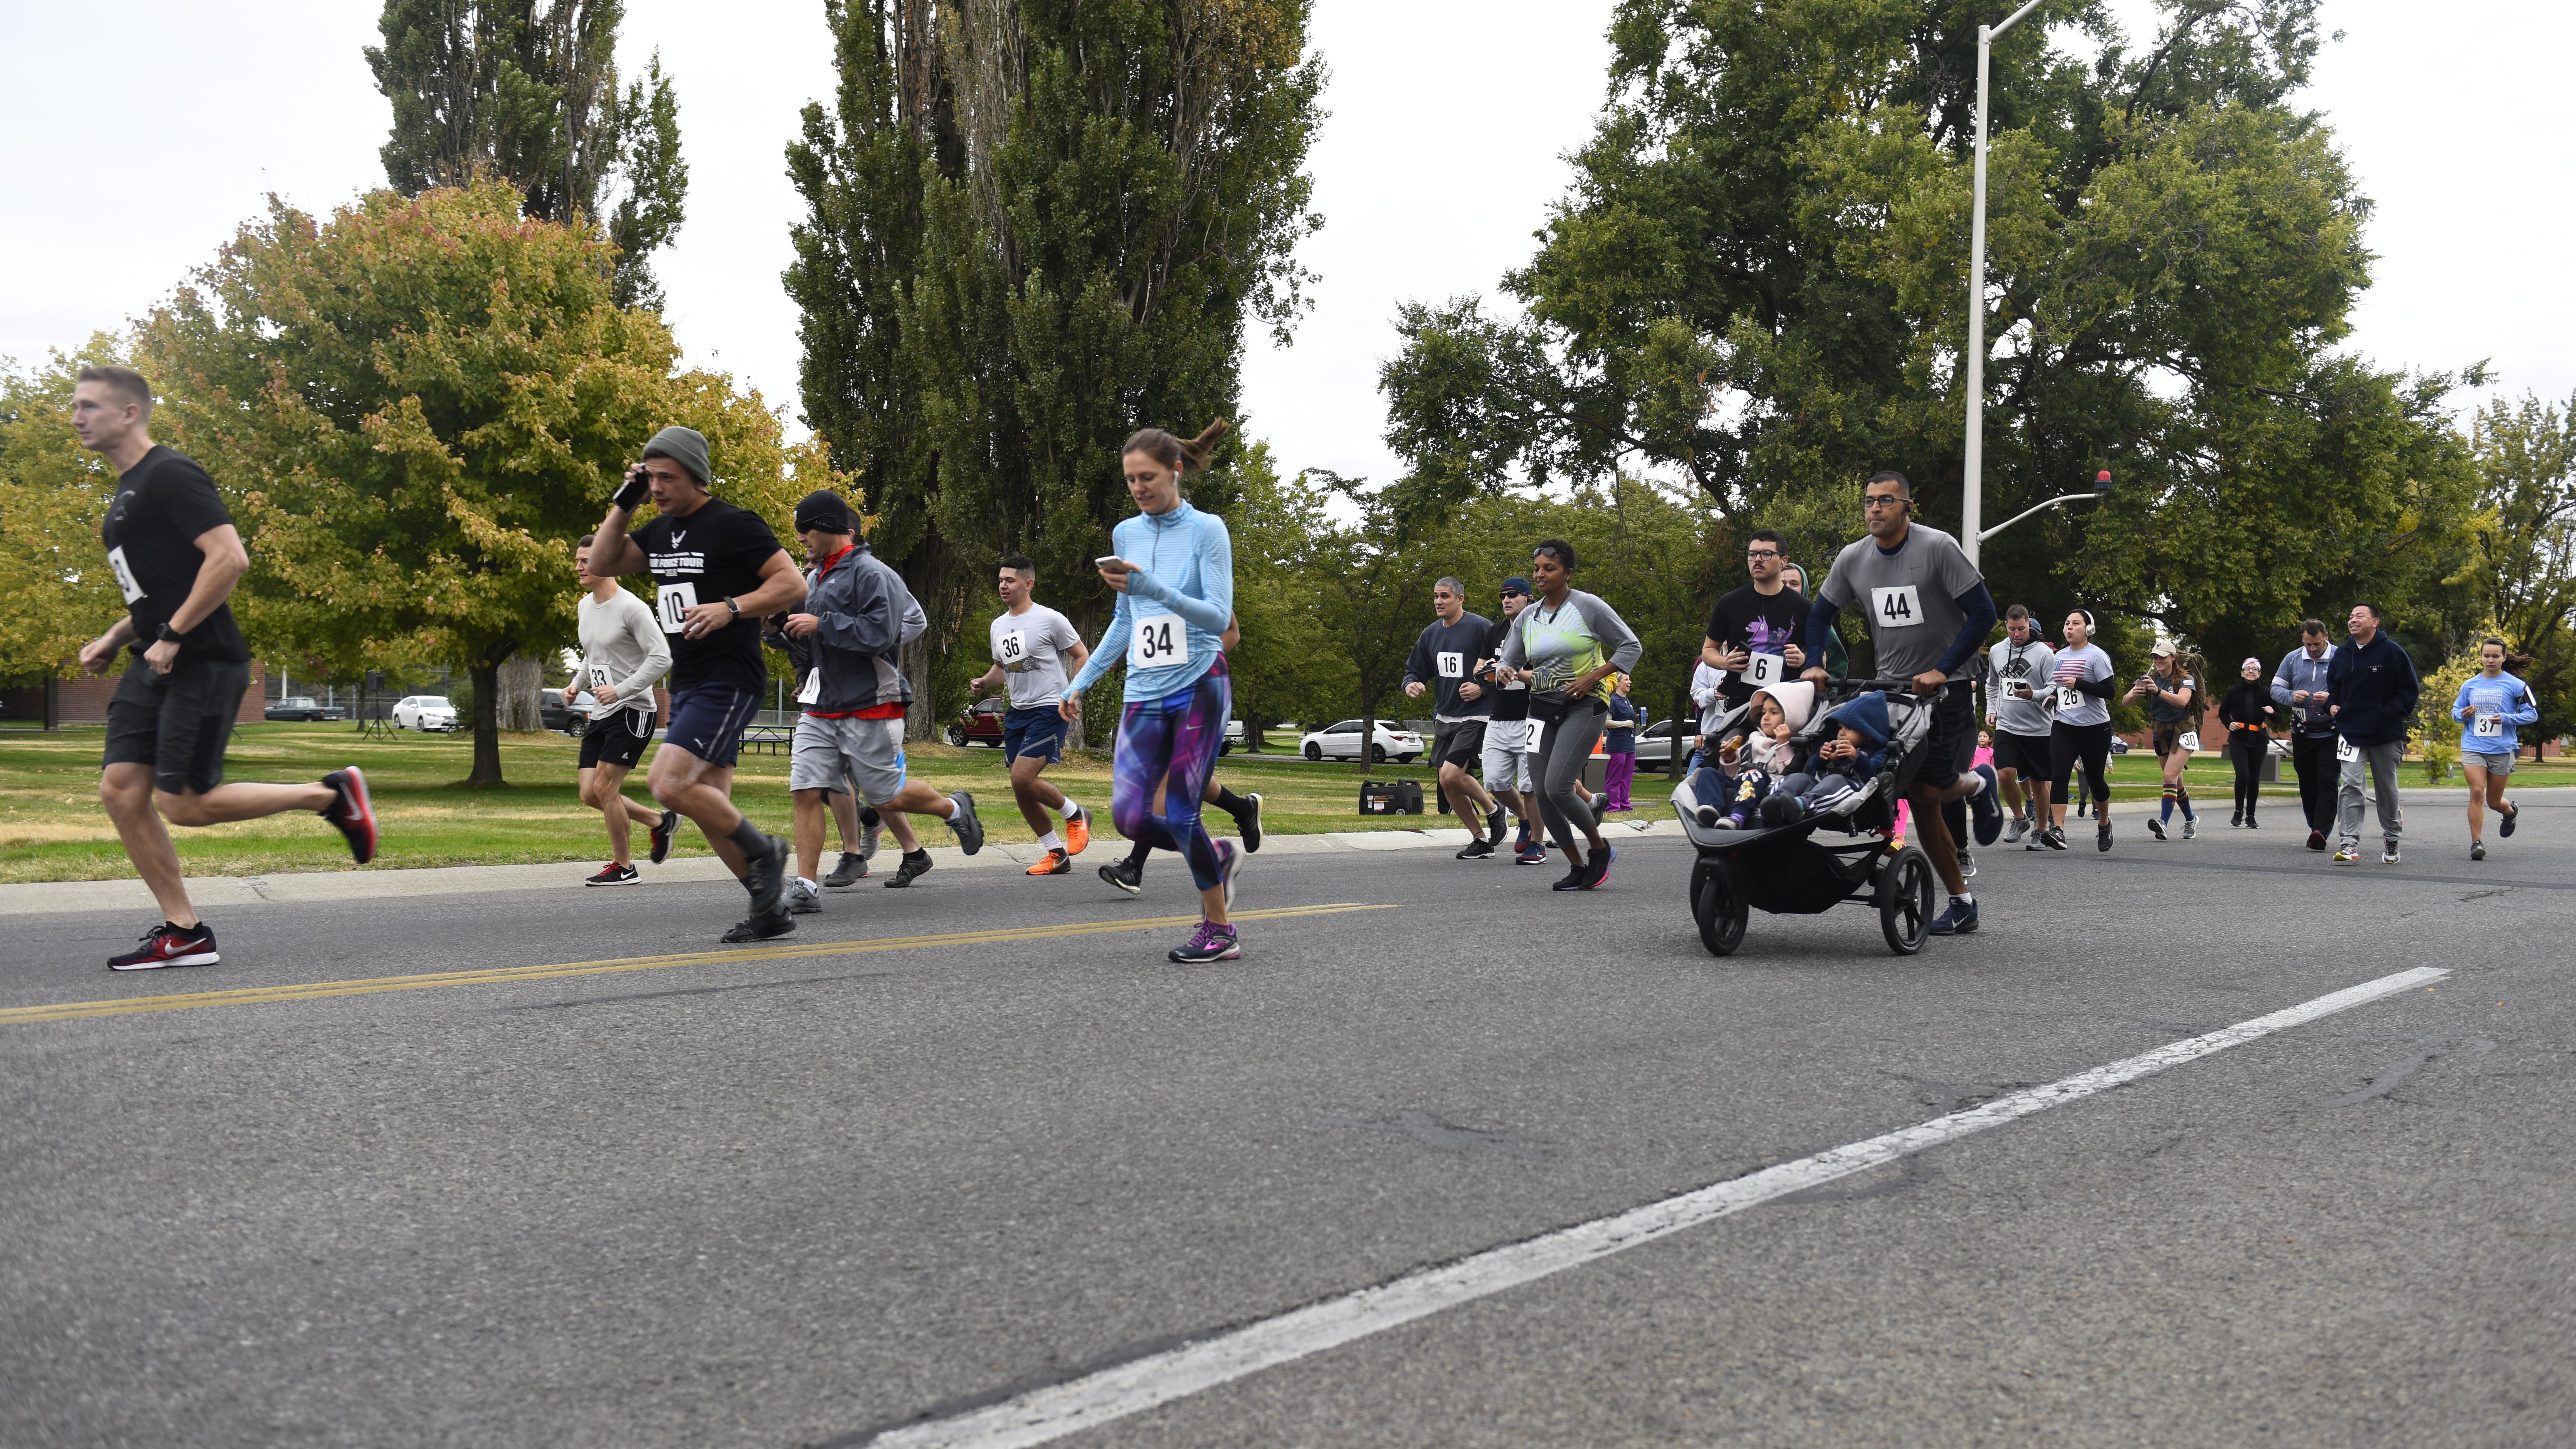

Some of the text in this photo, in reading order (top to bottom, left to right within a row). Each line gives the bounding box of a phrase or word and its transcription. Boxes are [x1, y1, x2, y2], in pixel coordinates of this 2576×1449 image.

[679, 557, 704, 567] TOUR
[665, 592, 686, 624] 10
[1884, 593, 1911, 620] 44
[1002, 636, 1020, 658] 36
[1143, 623, 1173, 658] 34
[1444, 656, 1456, 673] 16
[1755, 658, 1768, 680] 6
[592, 669, 607, 687] 33
[2063, 689, 2078, 705] 26
[2474, 696, 2500, 704] WARTHOG
[2475, 704, 2499, 713] RUGBY
[2480, 718, 2494, 733] 37
[2182, 734, 2195, 746] 30
[2337, 740, 2352, 756] 45
